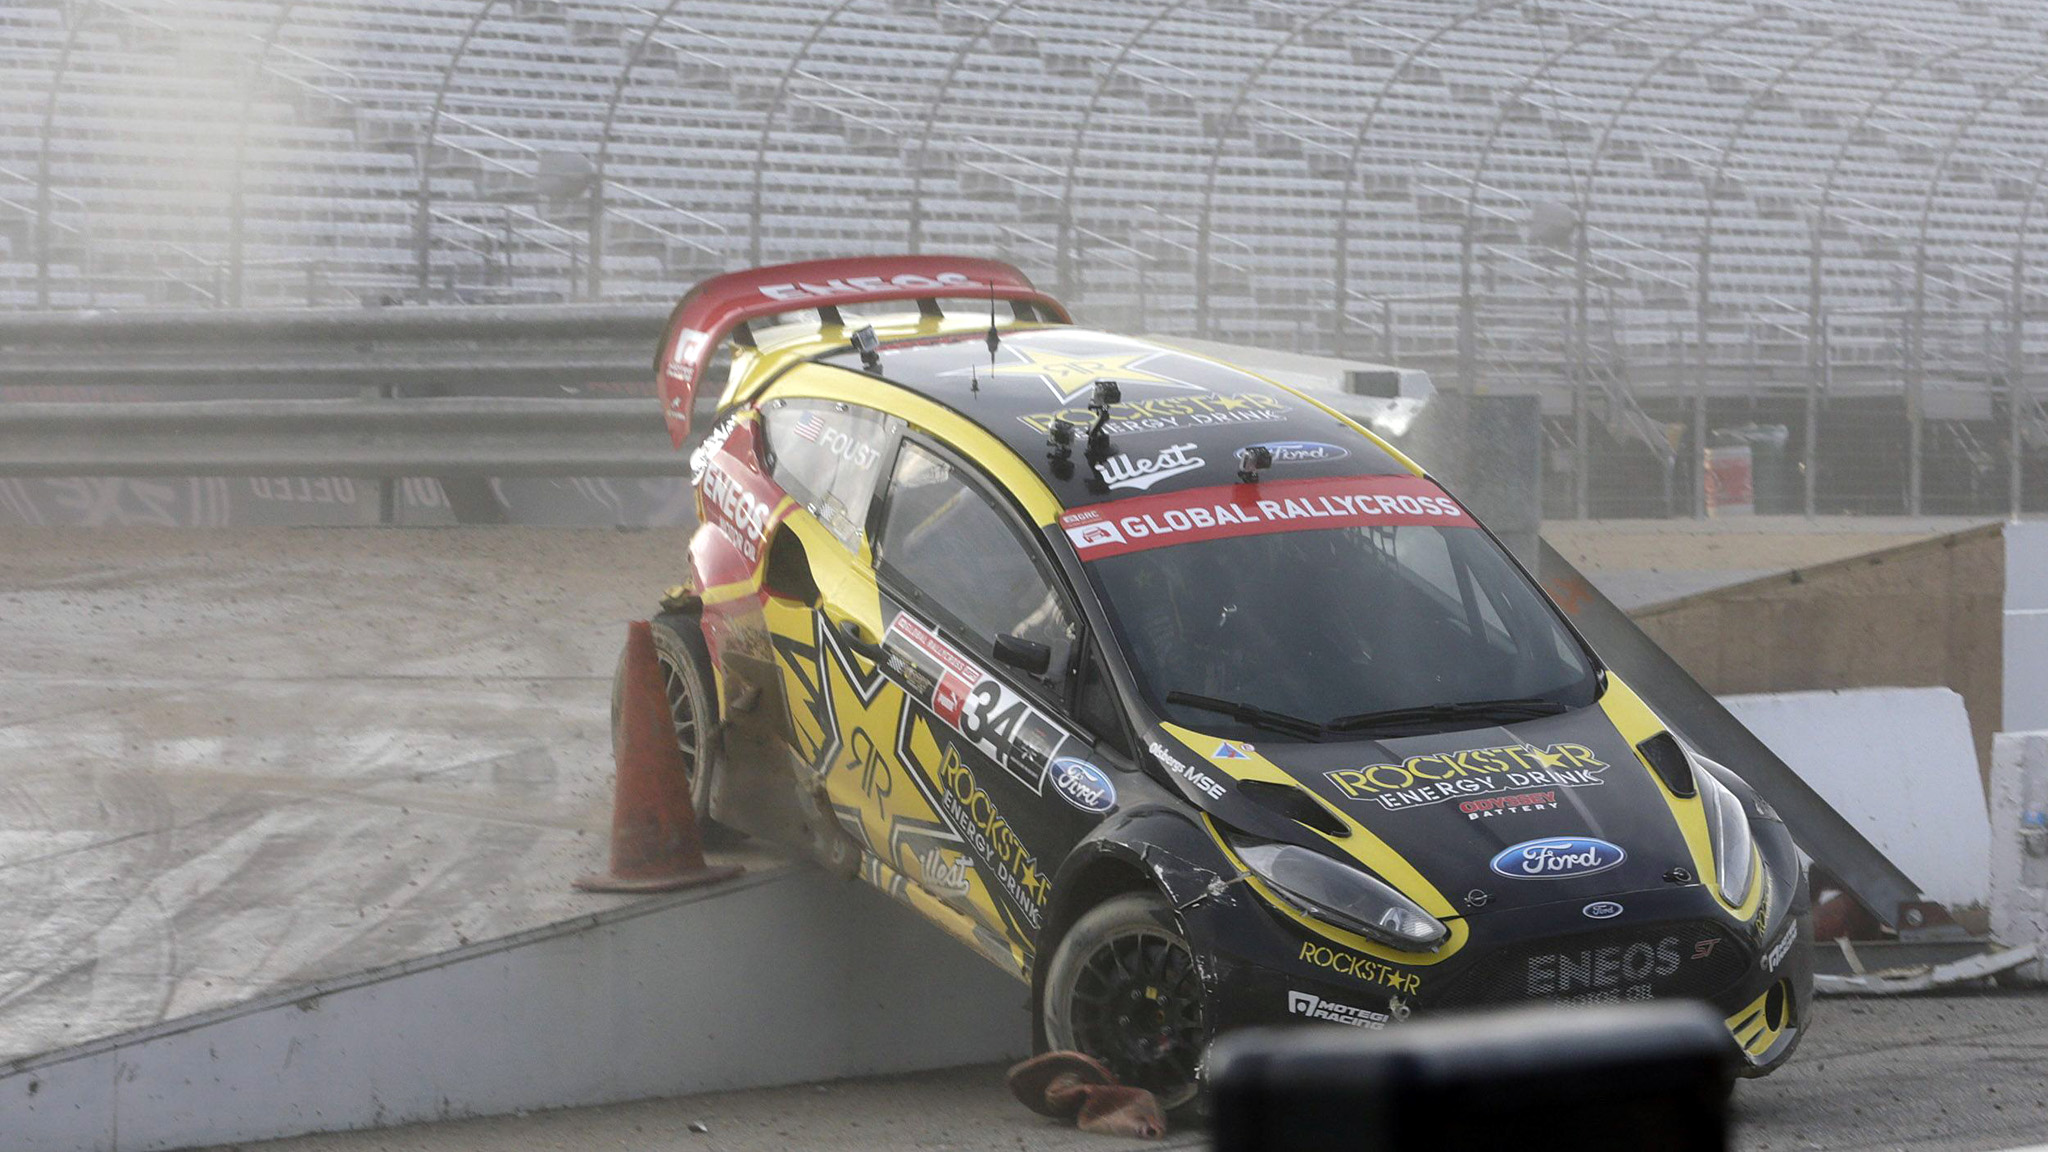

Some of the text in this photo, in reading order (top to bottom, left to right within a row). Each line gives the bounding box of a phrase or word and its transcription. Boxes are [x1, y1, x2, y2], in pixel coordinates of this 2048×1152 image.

[758, 272, 983, 300] ENEOS
[1190, 410, 1280, 425] DRINK
[819, 426, 881, 470] FOUST
[1096, 443, 1205, 486] illest
[703, 459, 769, 540] ENEOS
[1077, 510, 1099, 521] GRC
[1120, 495, 1461, 538] GLOBAL RALLYCROSS
[960, 680, 1028, 767] 34
[1058, 764, 1104, 806] Ford
[1183, 766, 1226, 800] MSE
[1381, 769, 1595, 808] ENERGY DRINK
[1459, 790, 1556, 813] ODYSSEY
[1468, 802, 1558, 820] BATTERY
[944, 790, 1042, 924] ENERGY DRINK
[1522, 843, 1601, 874] Ford
[1527, 936, 1680, 995] ENEOS
[1691, 938, 1721, 960] ST
[1314, 1009, 1385, 1031] RACING
[1318, 1000, 1389, 1023] MOTEGI
